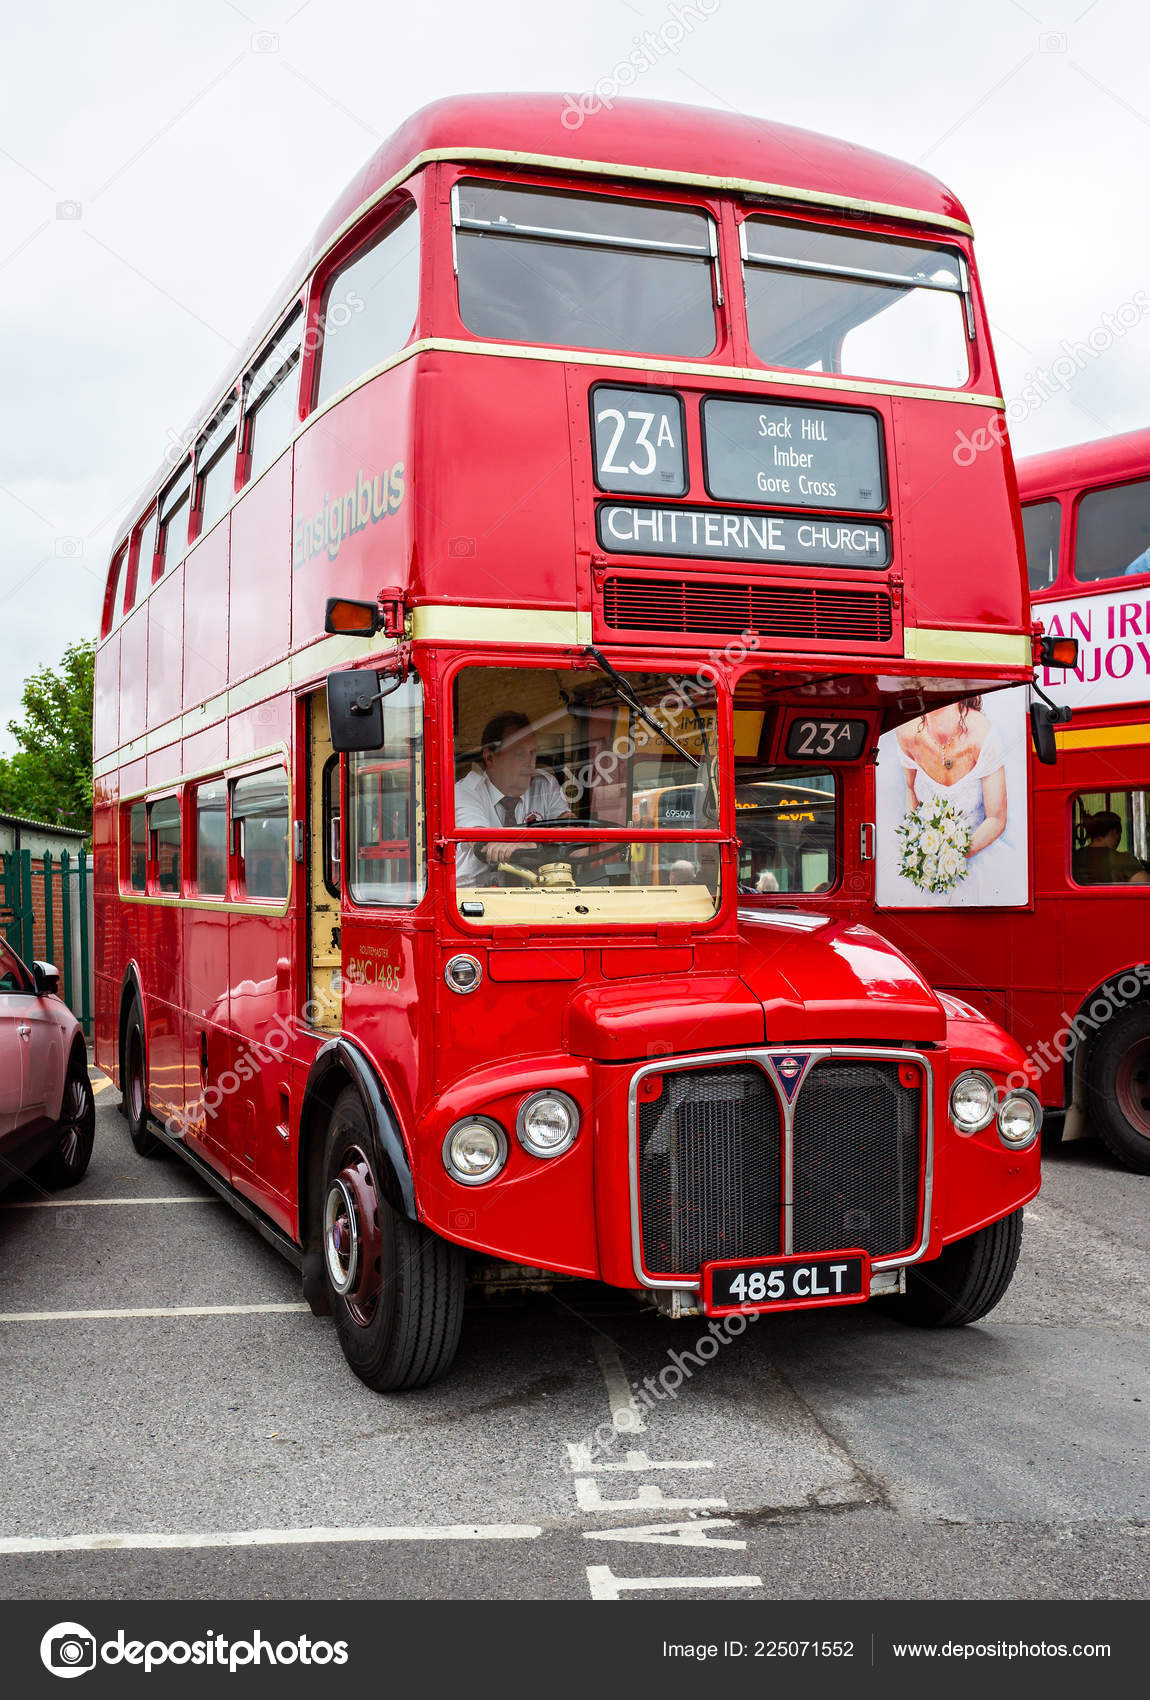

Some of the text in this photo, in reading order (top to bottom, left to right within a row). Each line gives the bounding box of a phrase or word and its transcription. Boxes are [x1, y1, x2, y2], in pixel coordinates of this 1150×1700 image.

[597, 408, 675, 476] 23A
[758, 415, 828, 442] Sack Hill
[773, 446, 814, 469] Imber
[757, 472, 791, 494] Gore
[798, 476, 837, 498] Cross
[293, 461, 405, 570] Ensignbus
[607, 508, 880, 552] CHITTERNE CHURCH
[1036, 601, 1150, 642] AN IR
[680, 716, 718, 730] IMBE
[797, 722, 851, 755] 23A
[665, 809, 691, 819] 69502
[359, 944, 389, 959] ROUTEMASTER
[729, 1264, 848, 1301] 485 CLT
